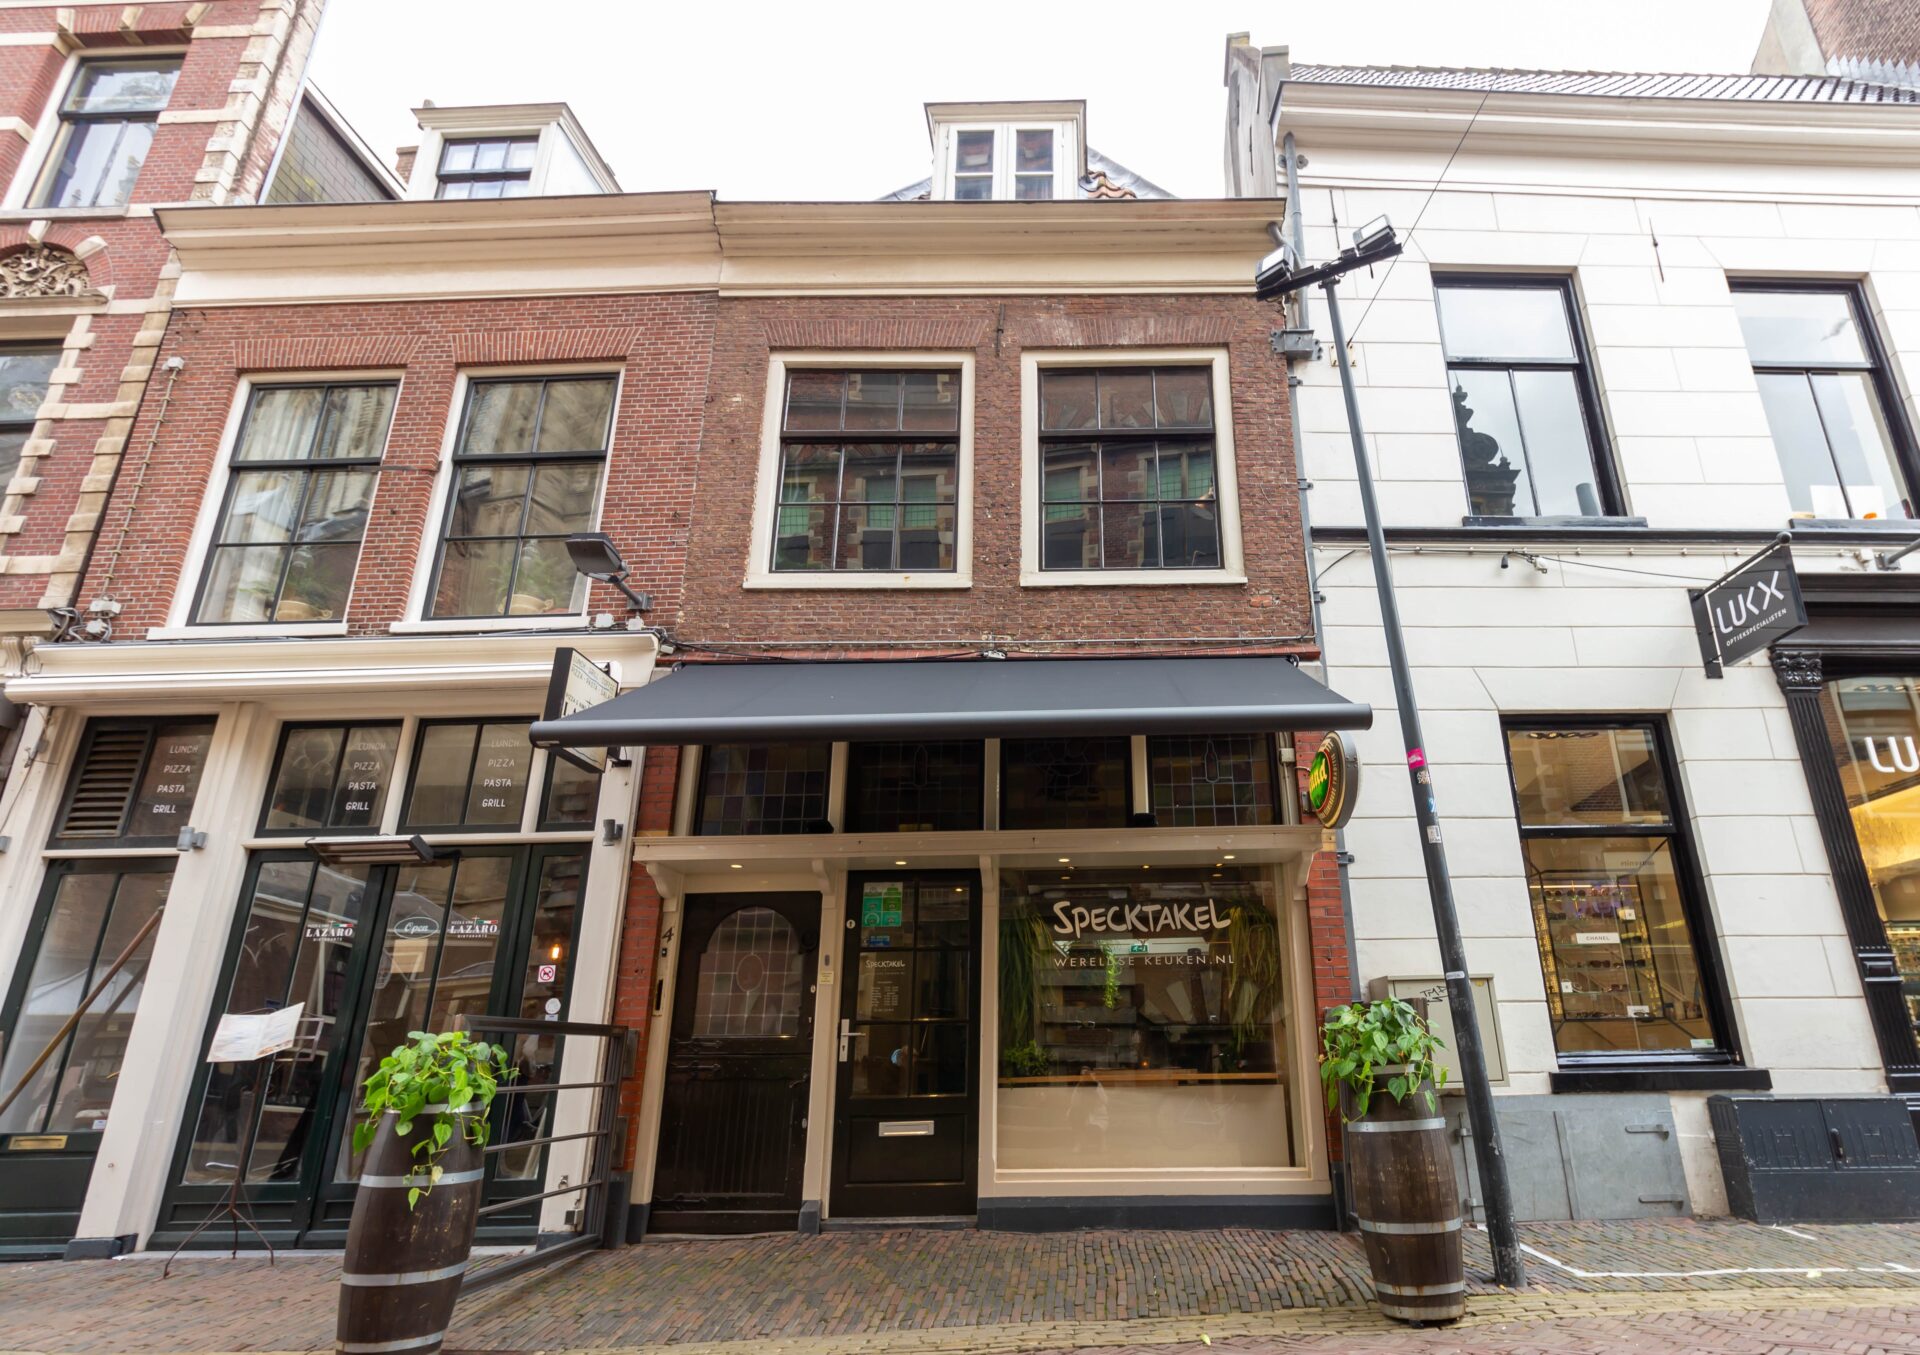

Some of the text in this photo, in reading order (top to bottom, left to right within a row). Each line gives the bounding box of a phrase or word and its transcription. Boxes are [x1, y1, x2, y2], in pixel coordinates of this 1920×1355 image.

[1726, 608, 1787, 647] OPTIEKSPECIALISTEN
[357, 742, 386, 751] LUNCH
[491, 739, 520, 748] LUNCH
[169, 745, 199, 754] LUNCH
[353, 762, 380, 771] PIZZA
[488, 759, 515, 767] PIZZA
[163, 765, 191, 774] PIZZA
[348, 781, 377, 790] PASTA
[484, 778, 512, 787] PASTA
[156, 784, 185, 793] PASTA
[345, 802, 370, 811] GRILL
[482, 798, 506, 808] GRILL
[152, 804, 177, 813] GRILL
[305, 927, 353, 938] LAZARO
[449, 924, 498, 934] LAZARO
[662, 926, 675, 944] 4
[1054, 956, 1136, 968] WERELDSE
